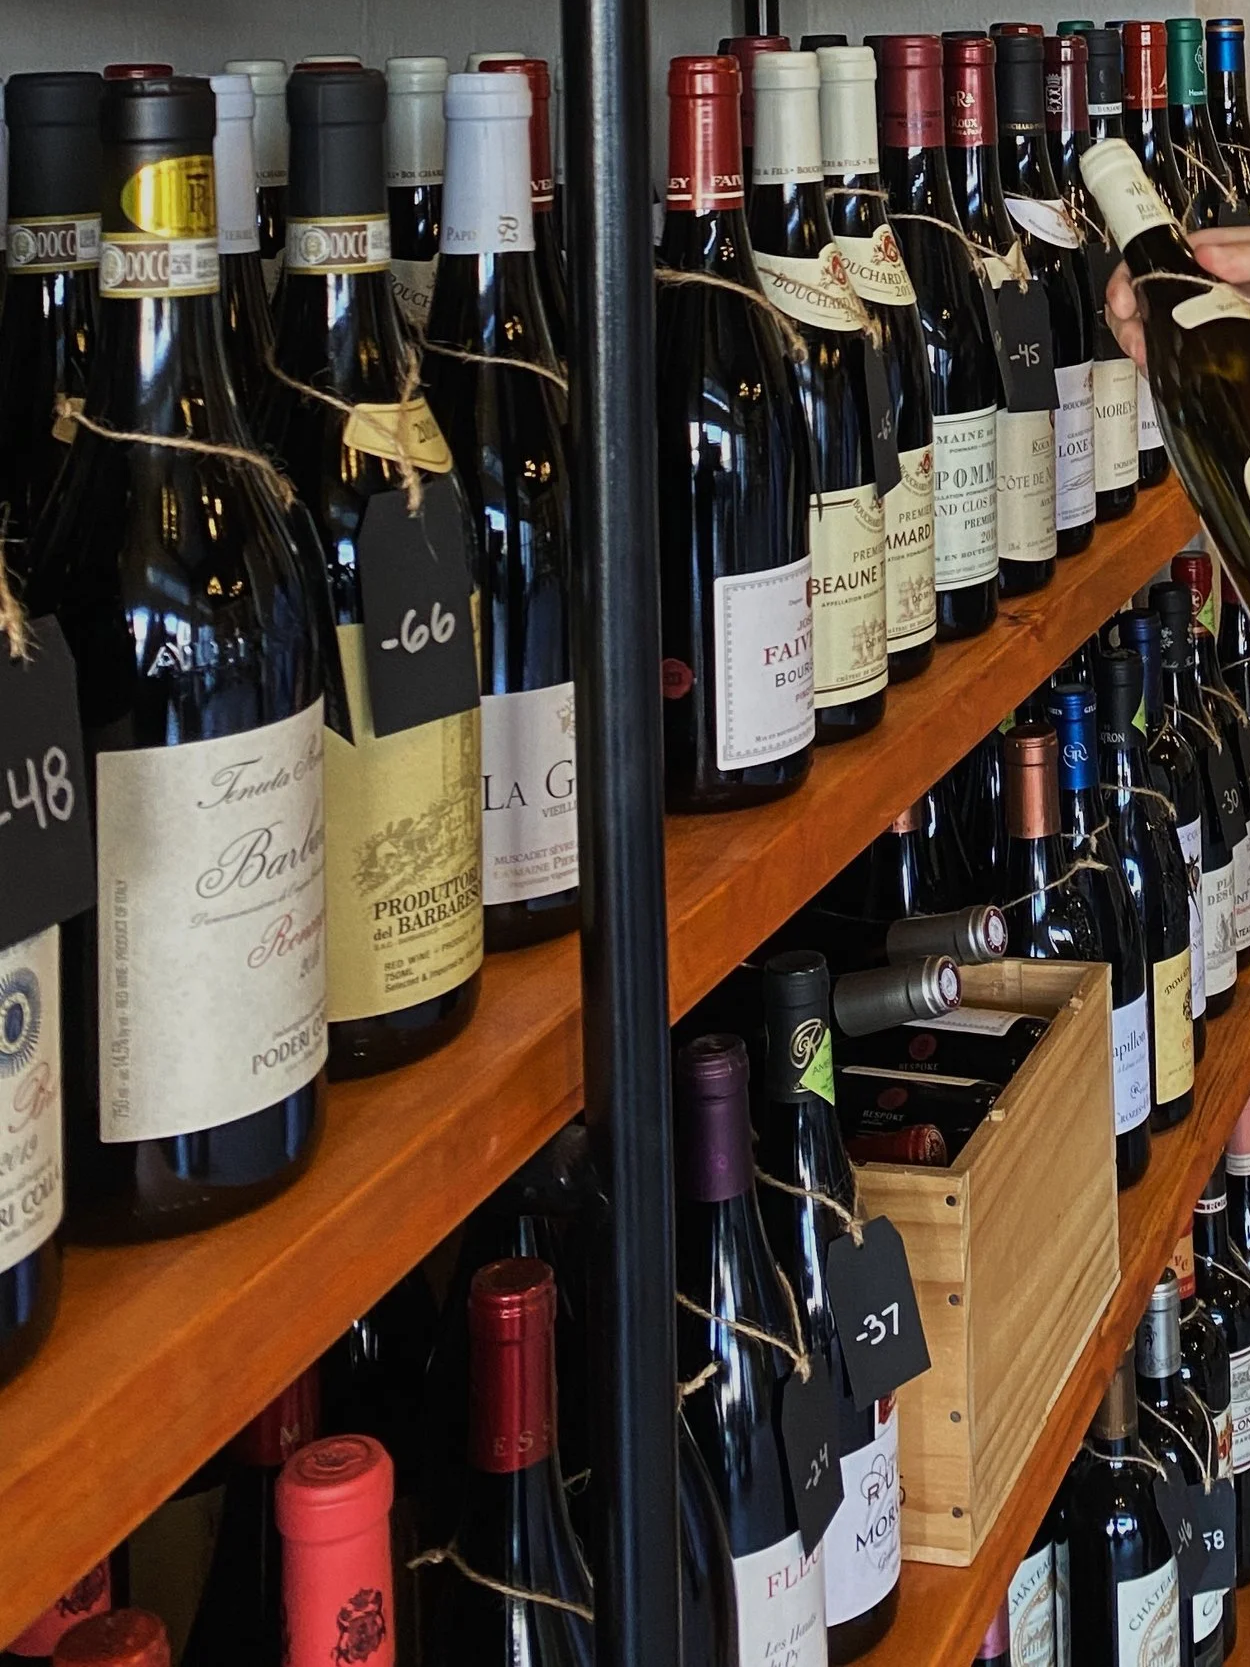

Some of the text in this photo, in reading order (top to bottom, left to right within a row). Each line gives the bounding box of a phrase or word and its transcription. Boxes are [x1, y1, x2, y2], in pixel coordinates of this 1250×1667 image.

[531, 180, 553, 192] VE
[840, 256, 901, 286] OUCHARD
[1009, 342, 1040, 368] -45
[997, 474, 1030, 492] CÔTE
[812, 565, 878, 595] BEAUNE
[381, 604, 456, 654] -66
[0, 746, 76, 831] -48
[196, 756, 291, 808] Tenuta
[482, 774, 529, 813] LA
[1221, 788, 1239, 816] -30
[373, 924, 394, 942] del
[251, 1027, 311, 1076] PODERI
[862, 1109, 905, 1122] BESPOKE
[855, 1302, 900, 1346] -37
[804, 1441, 829, 1491] -24
[764, 1633, 788, 1659] Les
